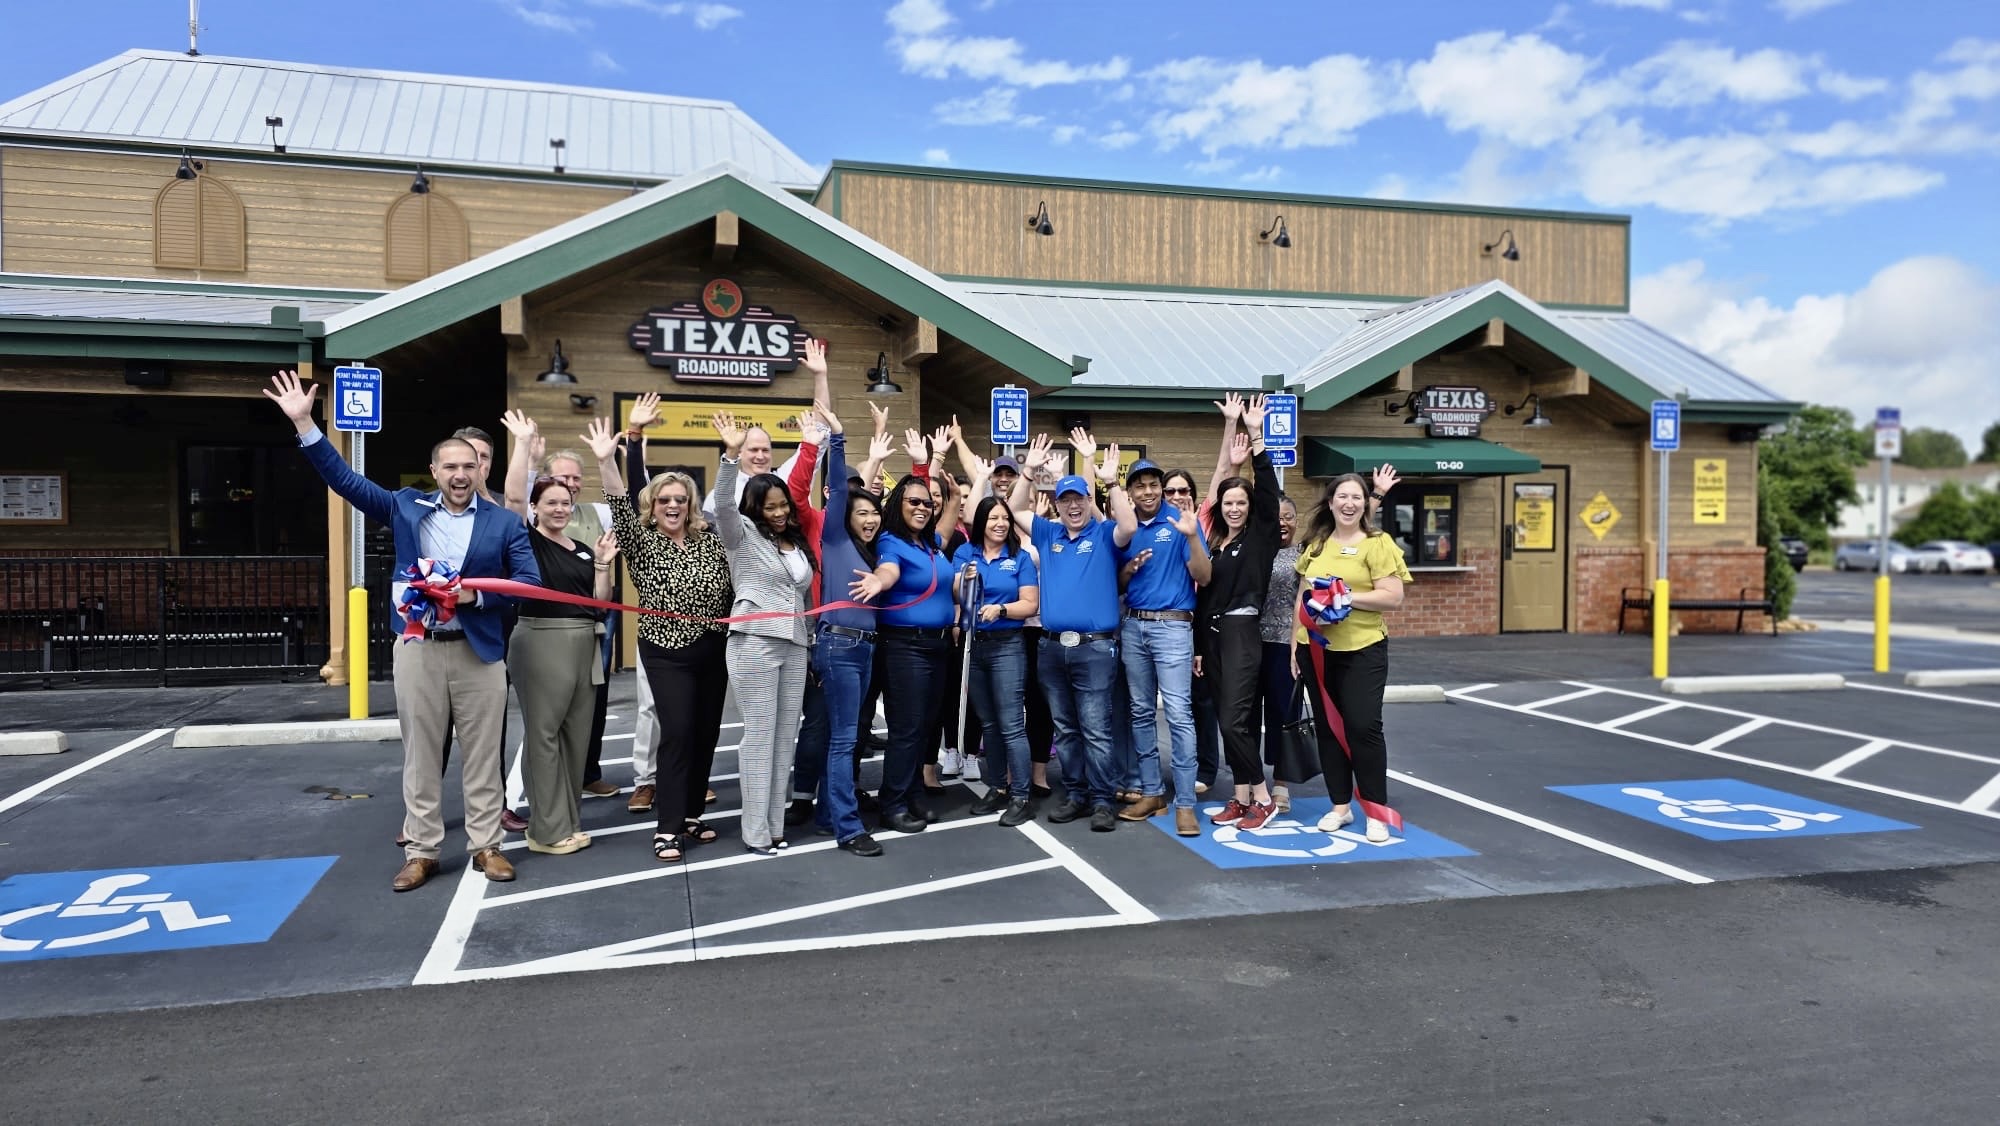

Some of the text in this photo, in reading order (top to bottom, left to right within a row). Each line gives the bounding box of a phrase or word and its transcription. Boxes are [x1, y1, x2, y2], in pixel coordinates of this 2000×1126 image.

[656, 319, 790, 357] TEXAS
[678, 358, 768, 377] ROADHOUSE
[1426, 391, 1486, 409] TEXAS
[1431, 412, 1481, 423] ROADHOUSE
[683, 420, 709, 429] AMIE
[1443, 426, 1469, 436] TO-GO
[1435, 461, 1464, 470] TO-GO
